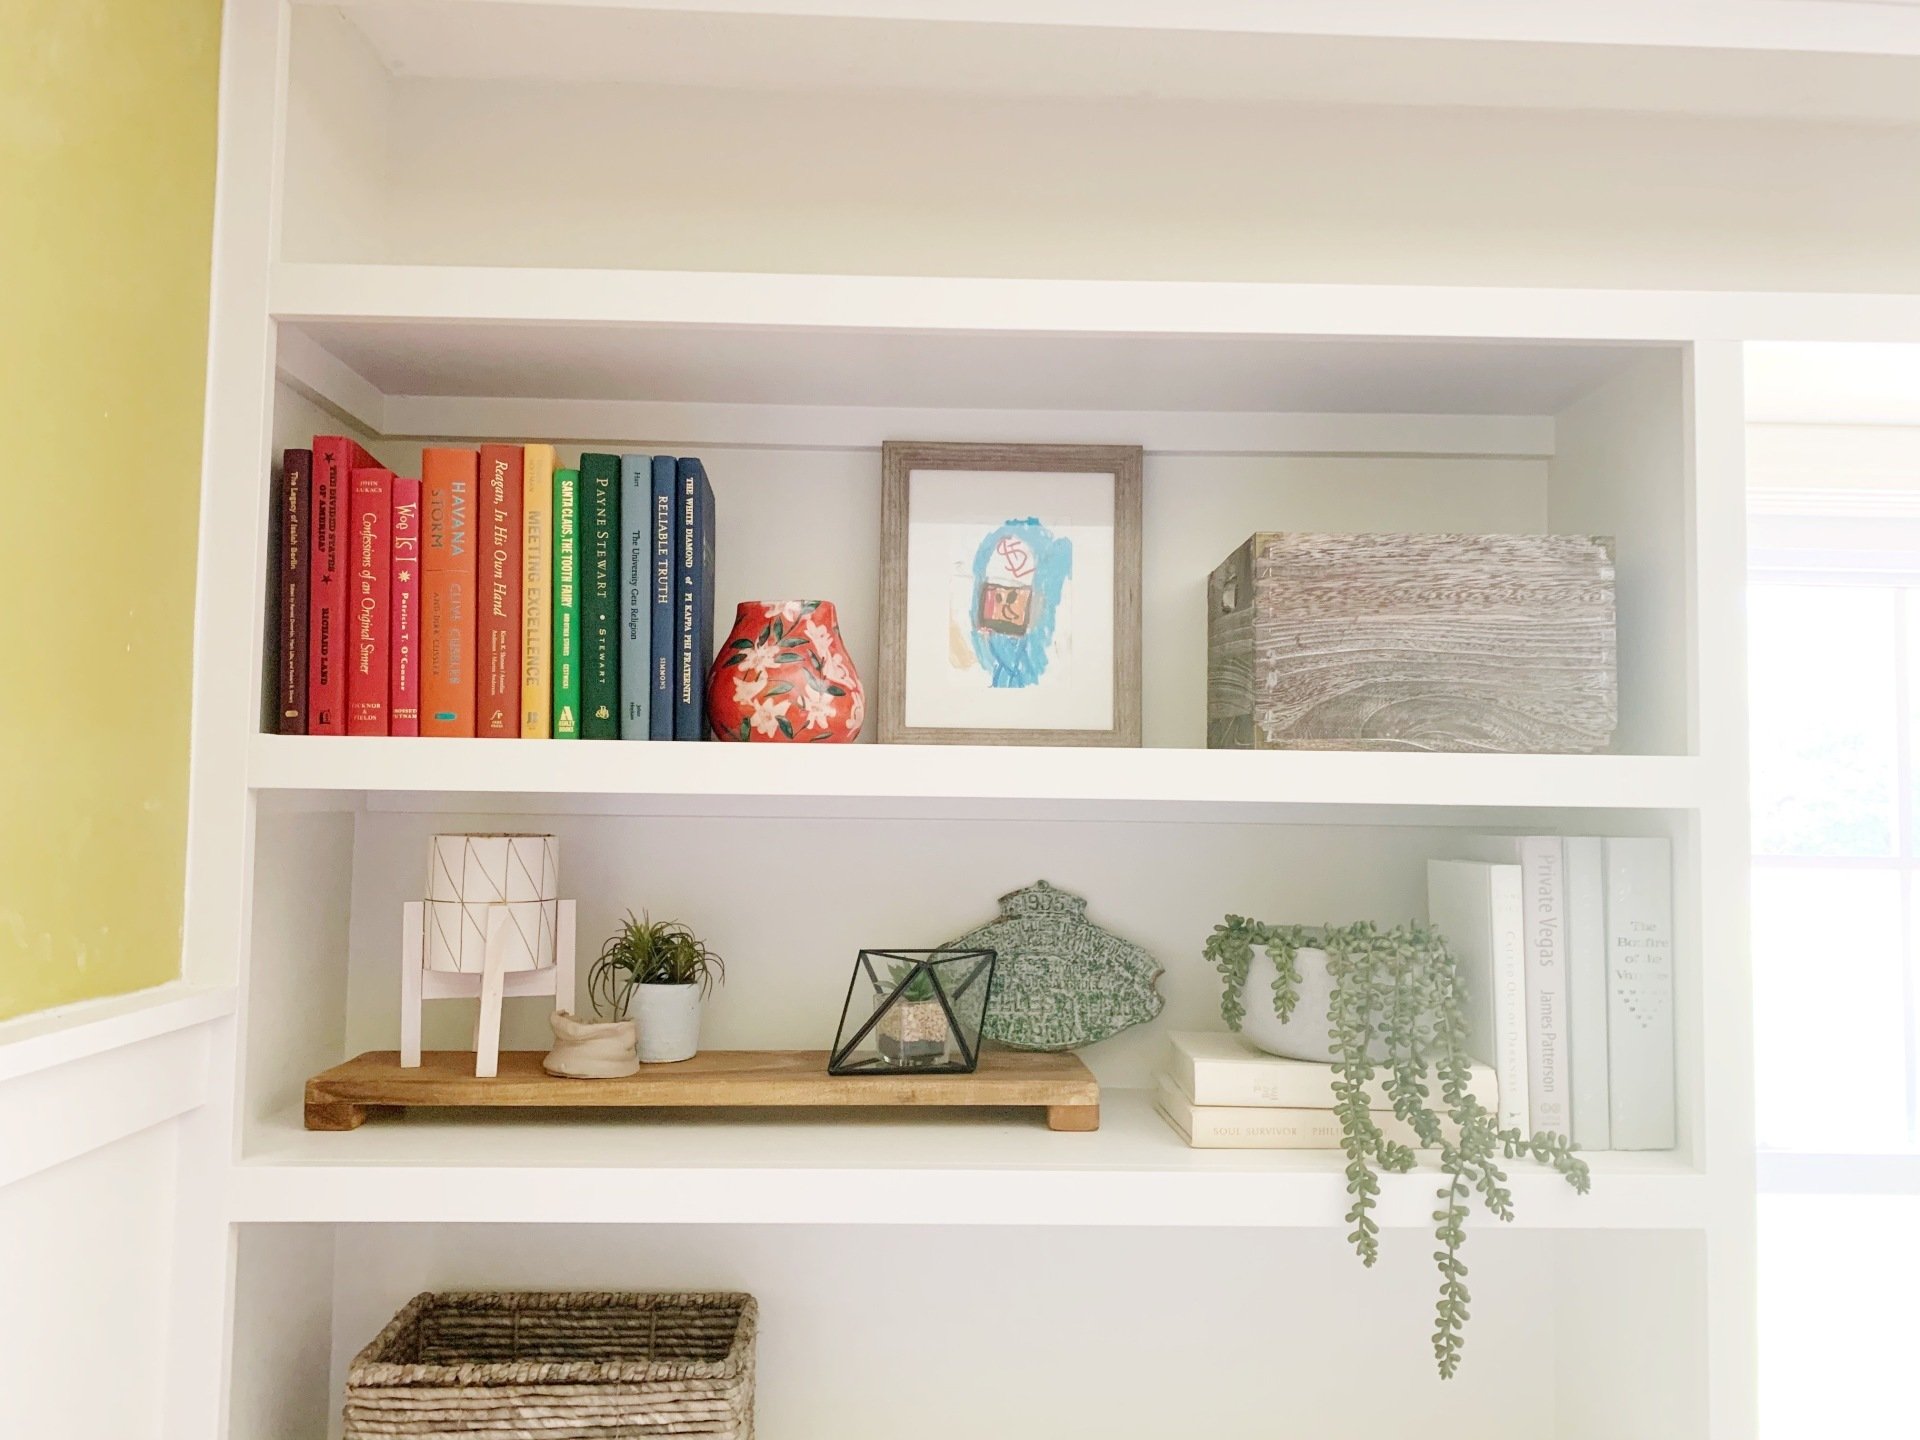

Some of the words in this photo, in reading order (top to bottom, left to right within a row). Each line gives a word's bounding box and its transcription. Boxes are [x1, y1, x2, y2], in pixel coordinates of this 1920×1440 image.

[290, 471, 299, 486] The
[330, 465, 338, 487] THE
[491, 460, 509, 505] Reagan,
[633, 472, 641, 487] Hart
[686, 477, 694, 495] THE
[289, 487, 298, 513] Legacy
[320, 484, 327, 498] OF
[561, 480, 574, 508] SANTA
[290, 514, 298, 523] of
[329, 490, 337, 532] DIVIDED
[394, 502, 417, 530] Woe
[431, 490, 444, 548] STORM
[451, 482, 466, 557] HAVANA
[494, 509, 508, 521] In
[560, 508, 573, 538] CLAUS,
[685, 497, 694, 526] WHITE
[290, 524, 298, 546] Isaiah
[494, 525, 508, 546] His
[632, 530, 641, 546] The
[658, 495, 669, 556] RELIABLE
[328, 533, 336, 572] STATES
[359, 512, 378, 568] Confessions
[528, 511, 541, 582] MEETING
[561, 538, 573, 554] THE
[685, 528, 693, 568] DIAMOND
[290, 547, 298, 570] Berlin
[494, 550, 508, 578] Own
[561, 555, 573, 582] TOOTH
[629, 548, 640, 586] University
[358, 570, 377, 581] of
[361, 582, 371, 595] an
[657, 560, 668, 604] TRUTH
[685, 576, 693, 585] of
[492, 581, 507, 617] Hand
[561, 584, 572, 608] FAIRY
[630, 588, 639, 605] Gets
[684, 593, 692, 602] PI
[357, 597, 377, 641] Original
[401, 592, 409, 630] Patricia
[628, 608, 639, 640] Religion
[684, 605, 692, 632] KAPPA
[321, 608, 330, 656] RICHARD
[401, 634, 409, 643] T.
[526, 587, 541, 686] EXCELLENCE
[683, 634, 692, 649] PHI
[320, 658, 329, 686] LAND
[359, 643, 376, 675] Sinner
[682, 652, 691, 704] FRATERNITY
[1538, 854, 1556, 913] Private
[1534, 917, 1559, 967] Vegas
[1540, 990, 1556, 1029] James
[1541, 1032, 1558, 1093] Patterson
[1246, 1127, 1297, 1136] SURVIVOR
